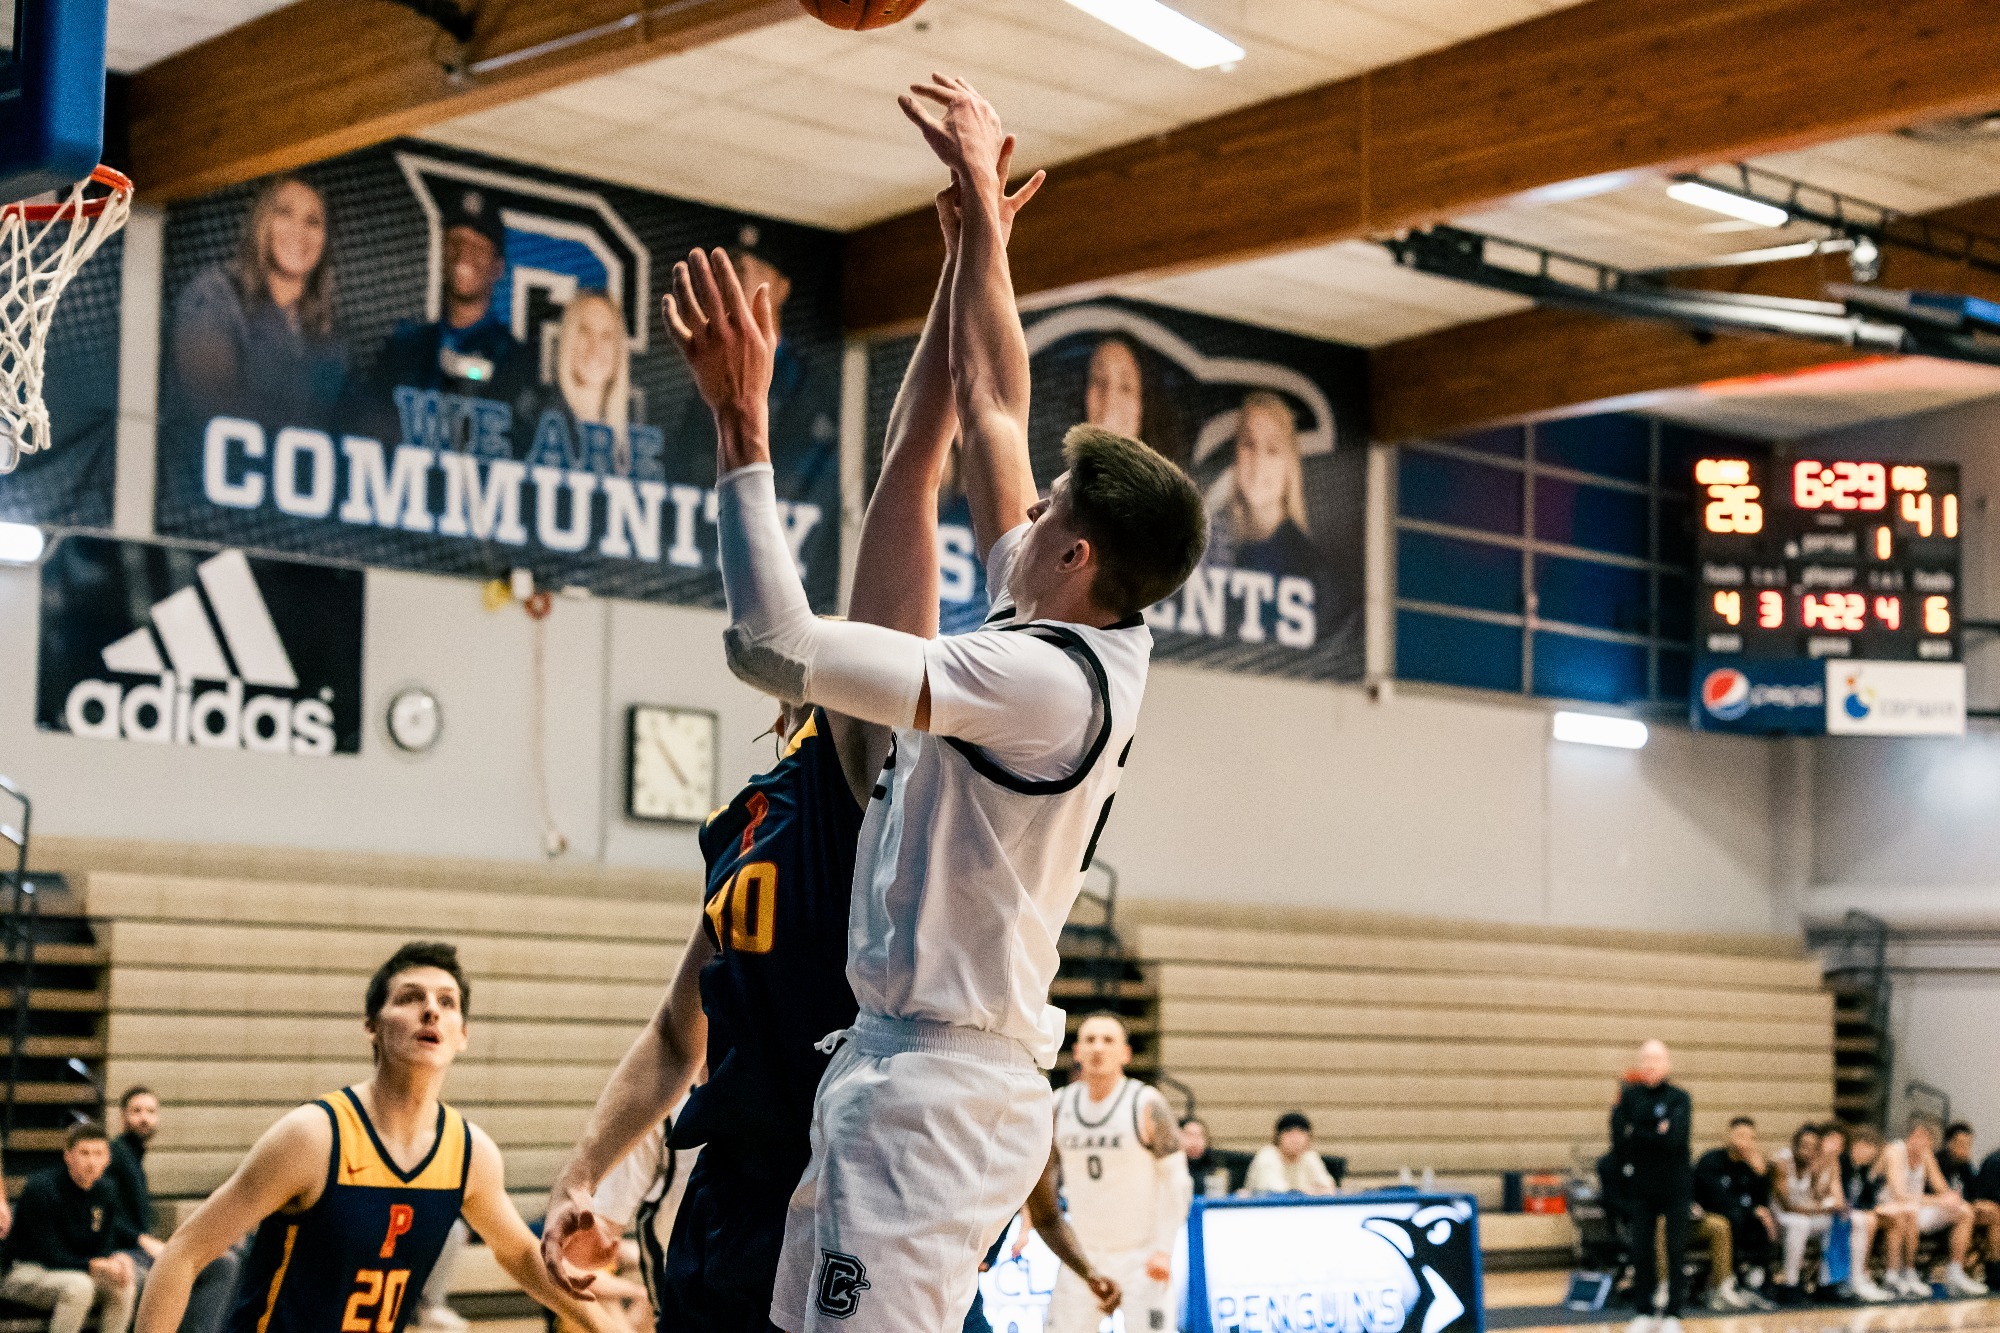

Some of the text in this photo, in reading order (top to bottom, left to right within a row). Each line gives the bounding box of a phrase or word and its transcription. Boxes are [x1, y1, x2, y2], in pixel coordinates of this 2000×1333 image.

[392, 384, 666, 482] WE ARE
[203, 415, 822, 581] COMMUNIY
[1705, 484, 1763, 533] 26
[1794, 460, 1886, 510] 6:29
[1902, 493, 1958, 538] 41
[1875, 526, 1892, 560] 1
[1713, 590, 1741, 626] 4
[1758, 590, 1783, 629] 3
[1874, 596, 1900, 630] 4
[65, 669, 338, 757] adidas
[1086, 1154, 1103, 1180] 0
[379, 1203, 415, 1259] P
[341, 1268, 412, 1333] 20
[1217, 1286, 1407, 1333] PENGUINS
